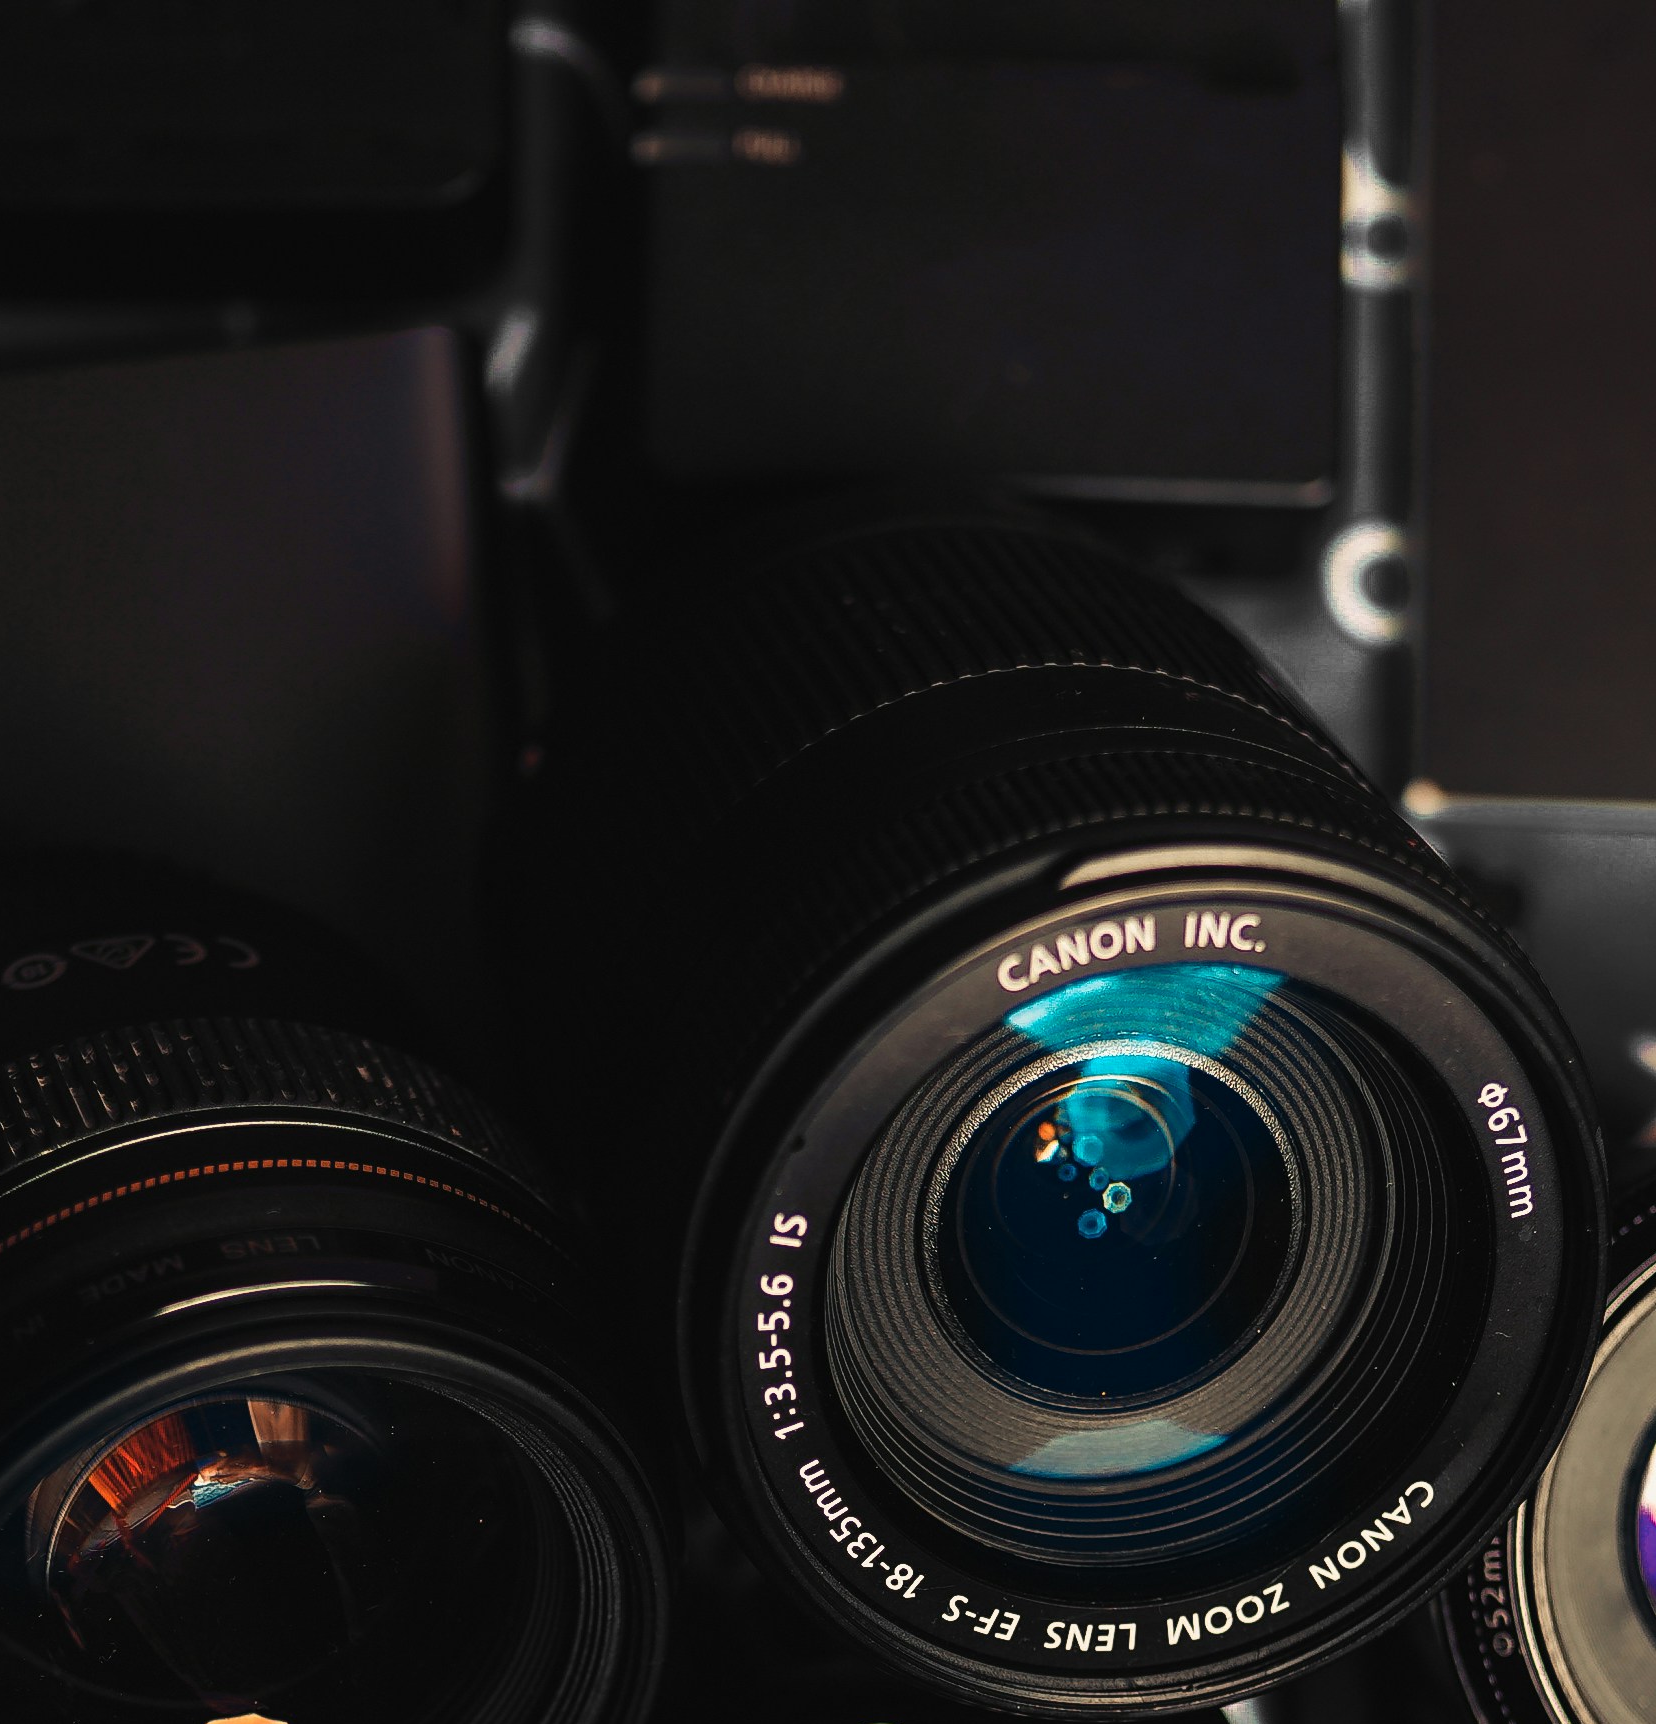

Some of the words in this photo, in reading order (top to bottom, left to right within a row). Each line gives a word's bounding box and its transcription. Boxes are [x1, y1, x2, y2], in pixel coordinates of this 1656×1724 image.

[997, 915, 1156, 992] CANON
[1184, 911, 1267, 953] INC.
[220, 1234, 322, 1260] LENS
[769, 1212, 809, 1249] IS
[77, 1253, 186, 1304] MADE
[757, 1273, 805, 1441] 1:3.5-5.6
[798, 1458, 926, 1600] 18-135mm
[1308, 1480, 1435, 1590] CANON
[941, 1593, 1022, 1642] EF-S
[1043, 1621, 1138, 1653] LENS
[1166, 1582, 1291, 1646] ZOOM
